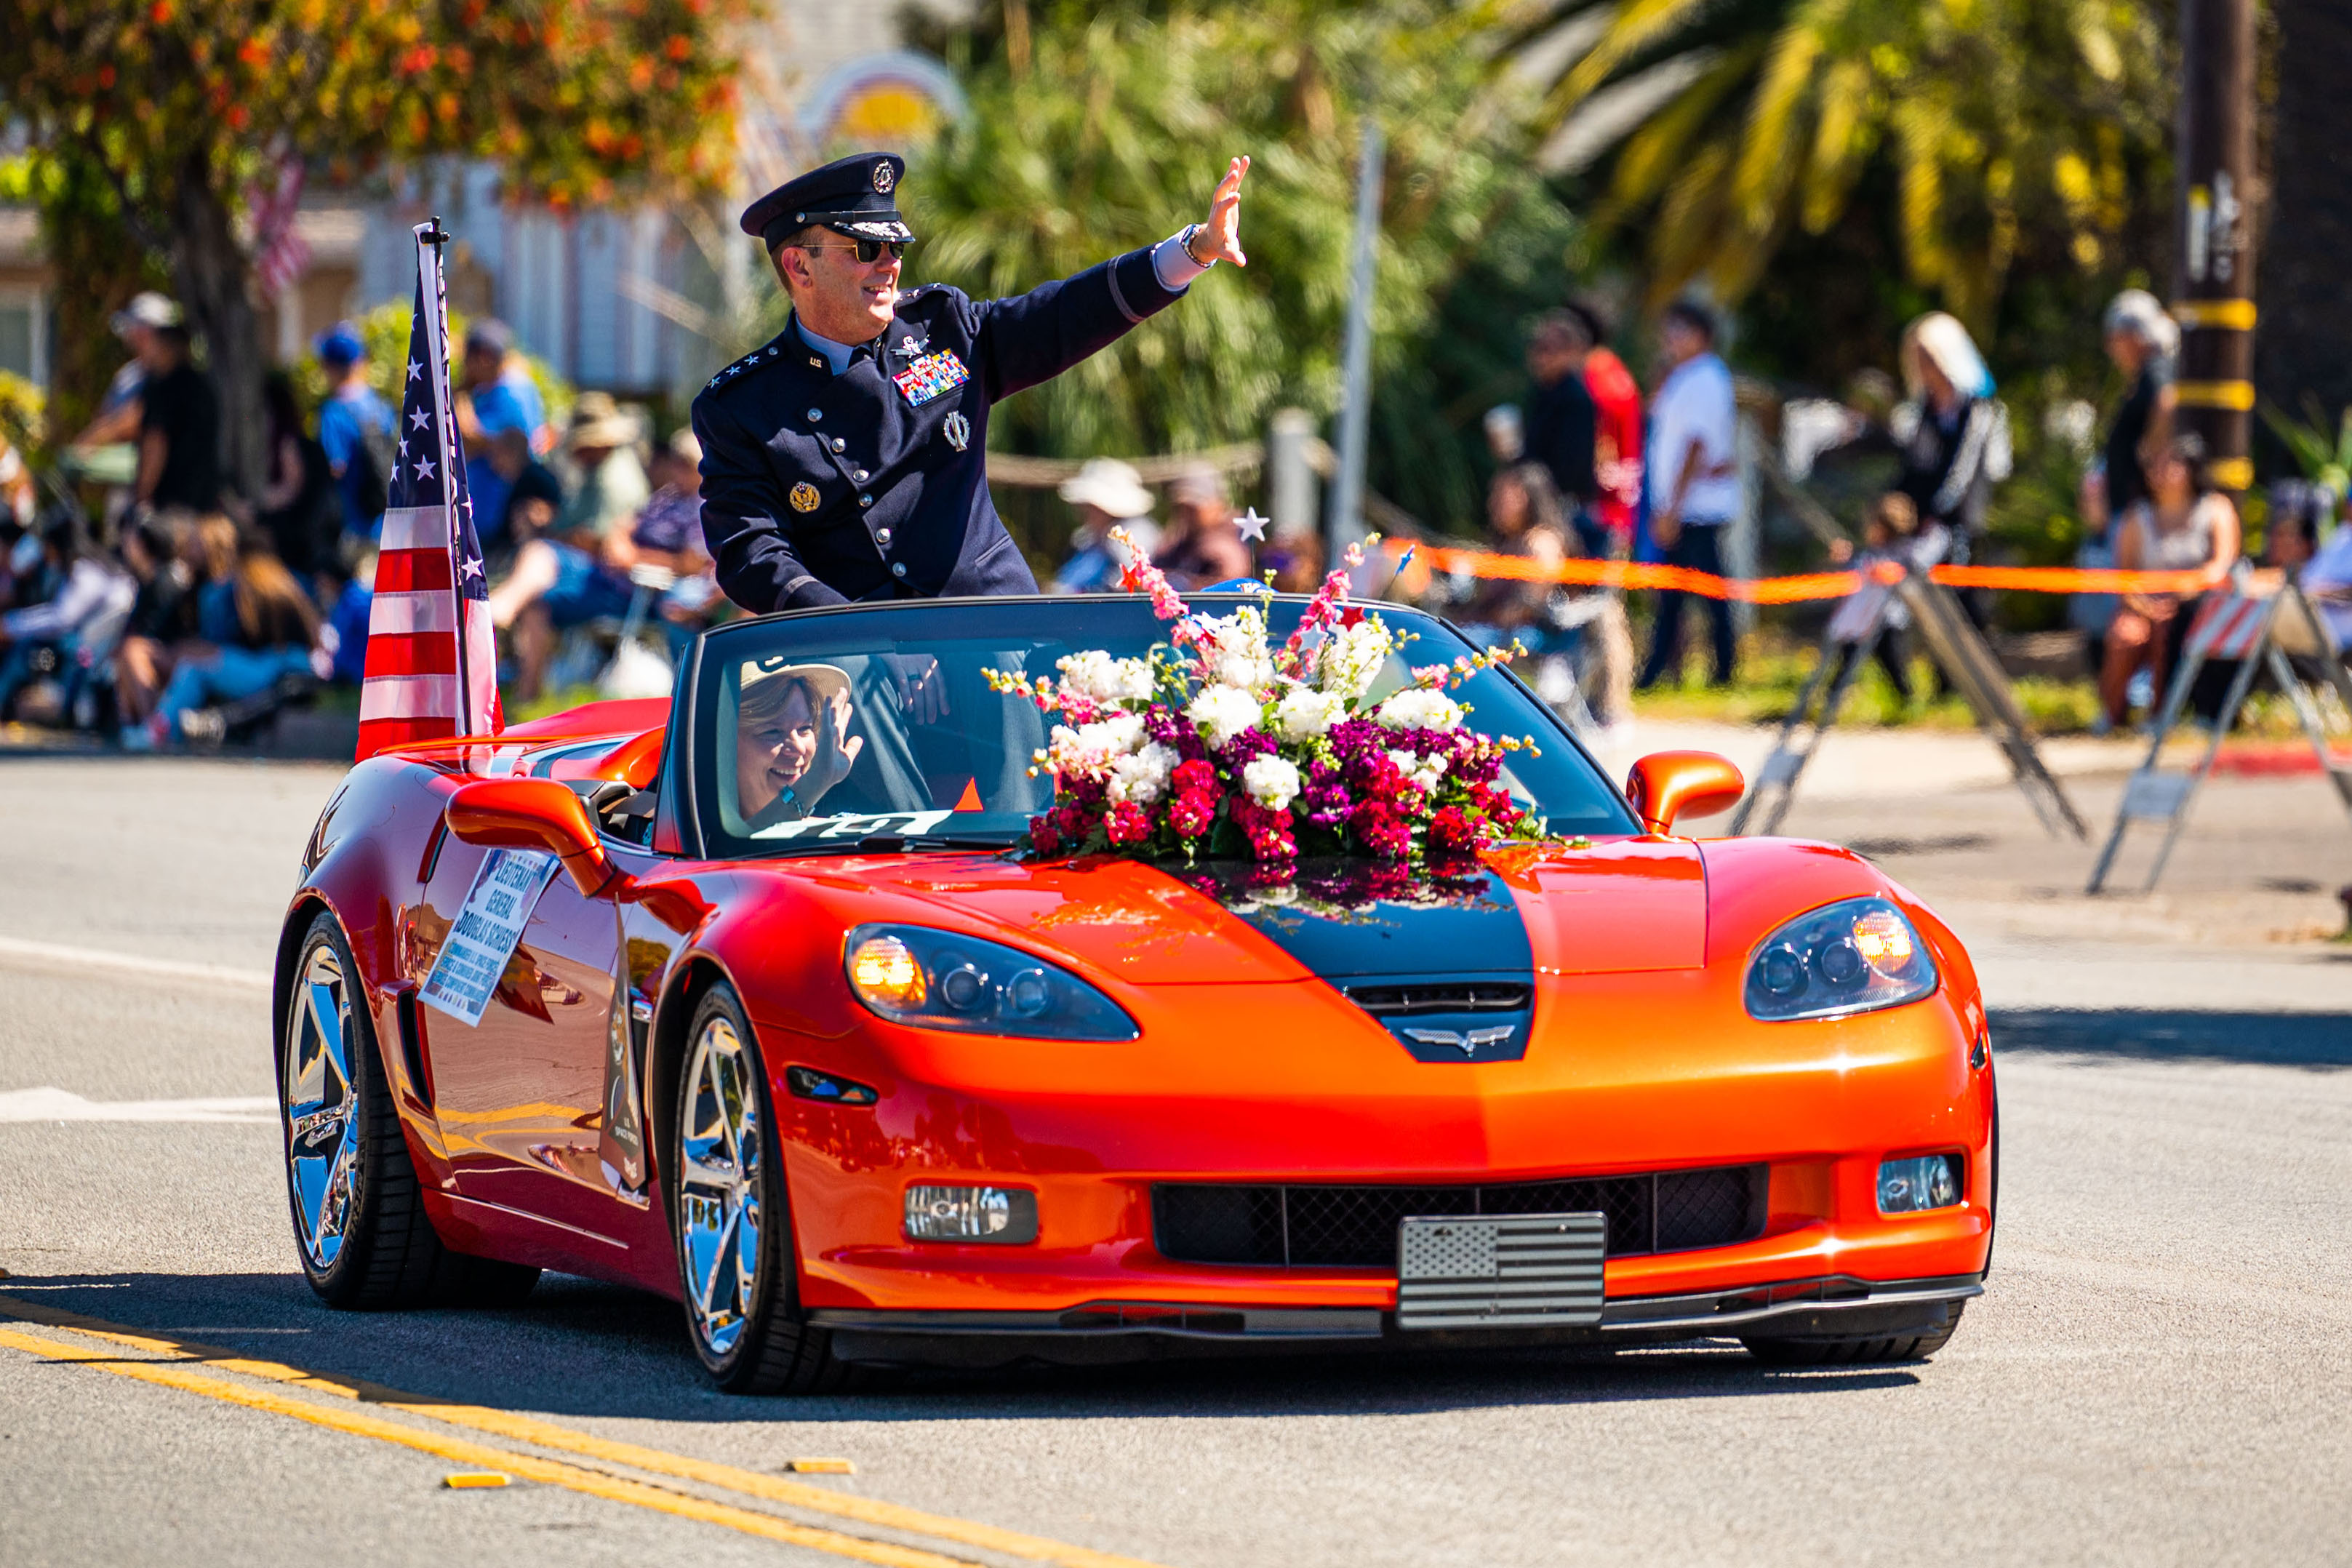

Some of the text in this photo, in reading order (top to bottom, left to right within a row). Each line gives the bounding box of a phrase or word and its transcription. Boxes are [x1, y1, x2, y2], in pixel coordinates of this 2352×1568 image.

[495, 859, 537, 892] LIEUTENANT
[485, 889, 517, 919] GENERAL
[456, 910, 492, 943] DOUGLAS
